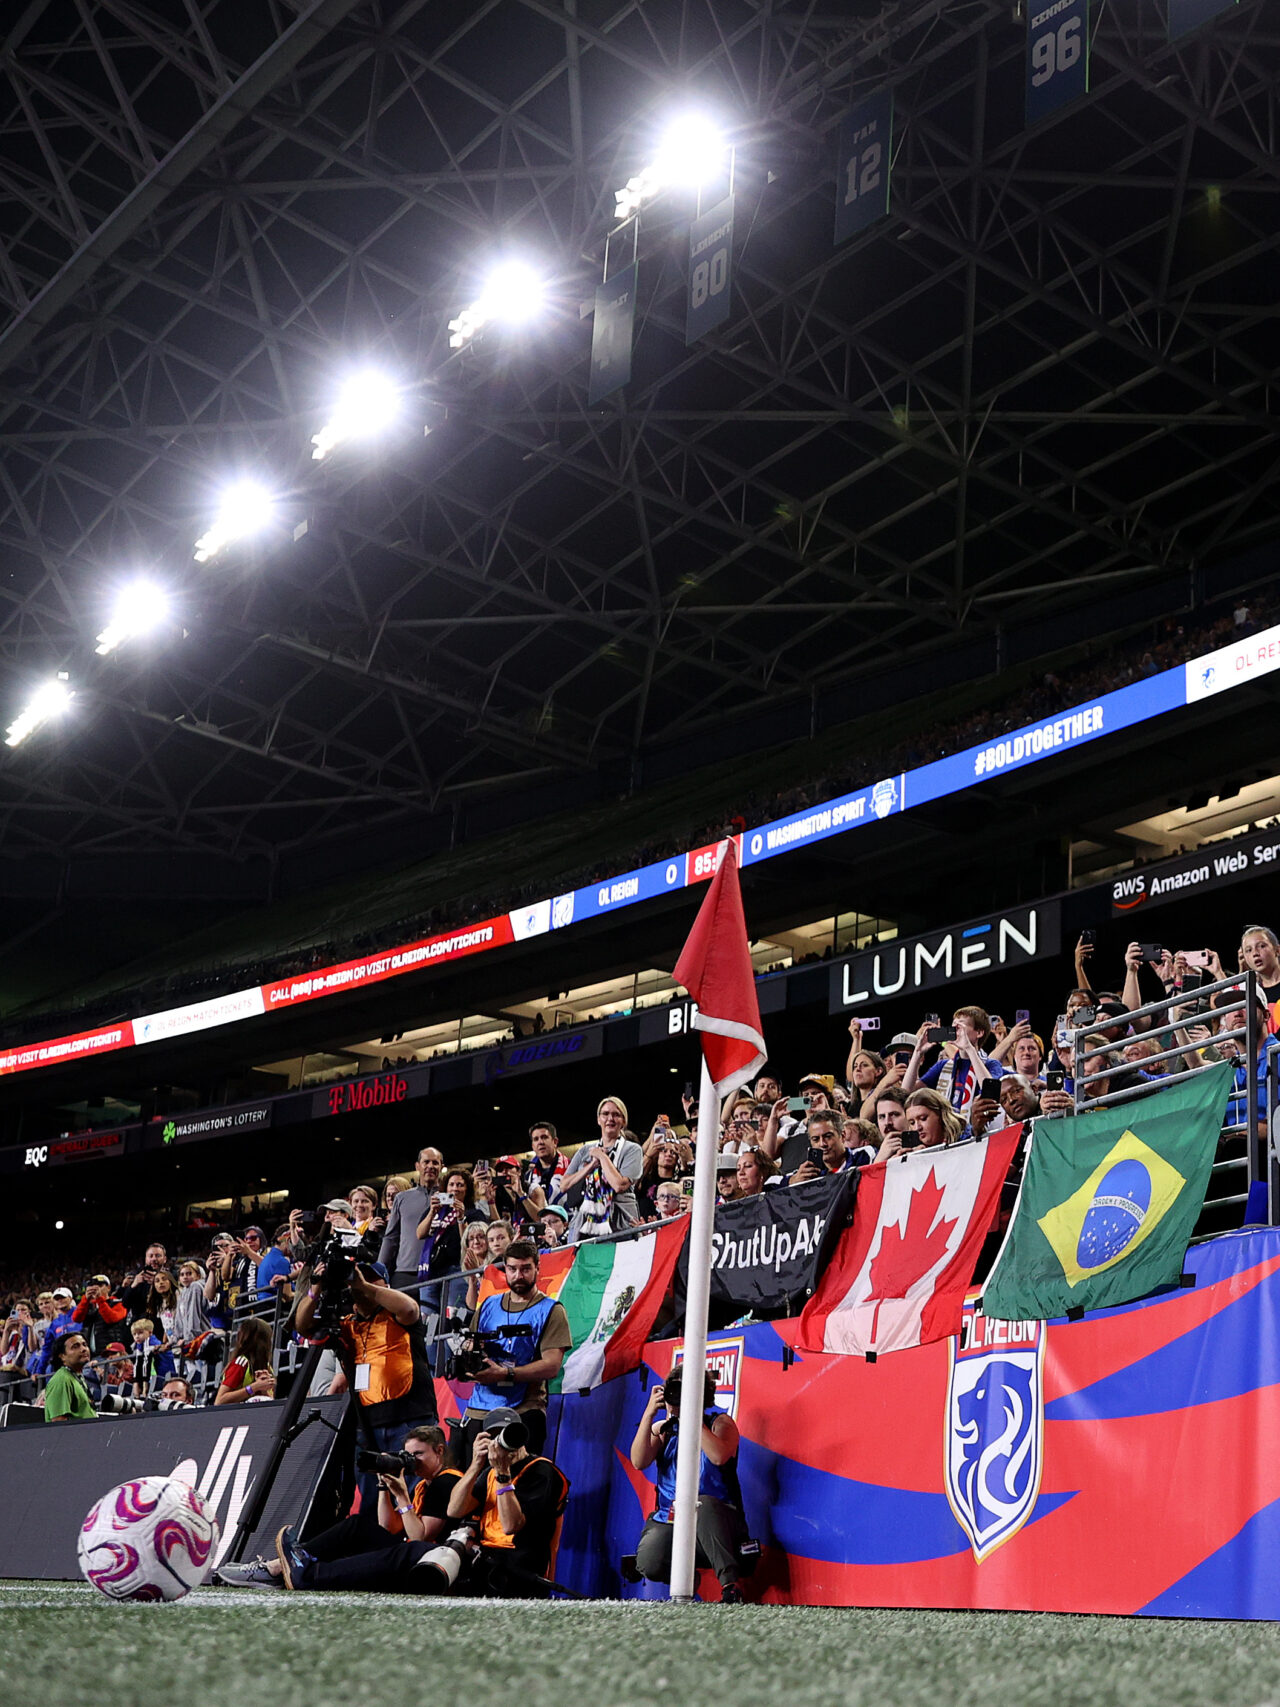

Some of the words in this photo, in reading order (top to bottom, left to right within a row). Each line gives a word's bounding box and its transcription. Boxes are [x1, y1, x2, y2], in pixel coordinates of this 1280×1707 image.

[1031, 15, 1083, 88] 96
[845, 142, 881, 206] 12
[692, 248, 728, 309] 80
[1236, 654, 1253, 672] OL
[973, 703, 1106, 776] #BOLDTOGETHER
[598, 888, 611, 906] OL
[611, 876, 640, 904] REIGN
[665, 863, 678, 885] 0
[750, 833, 763, 856] 0
[767, 808, 832, 851] WASHINGTON
[832, 797, 866, 827] SPIRIT
[1113, 875, 1145, 900] aws
[1149, 863, 1210, 897] Amazon
[1214, 853, 1248, 875] Web
[843, 909, 1037, 1006] LUMEN
[270, 988, 291, 1002] CALL
[354, 967, 366, 980] OR
[366, 958, 391, 977] VISIT
[18, 1049, 40, 1065] VISIT
[507, 1035, 584, 1068] BOEING
[347, 1074, 408, 1111] Mobile
[176, 1117, 233, 1137] WASHINGTON'S
[234, 1109, 268, 1127] LOTTERY
[24, 1145, 48, 1168] EQC
[984, 1314, 1037, 1347] REIGN
